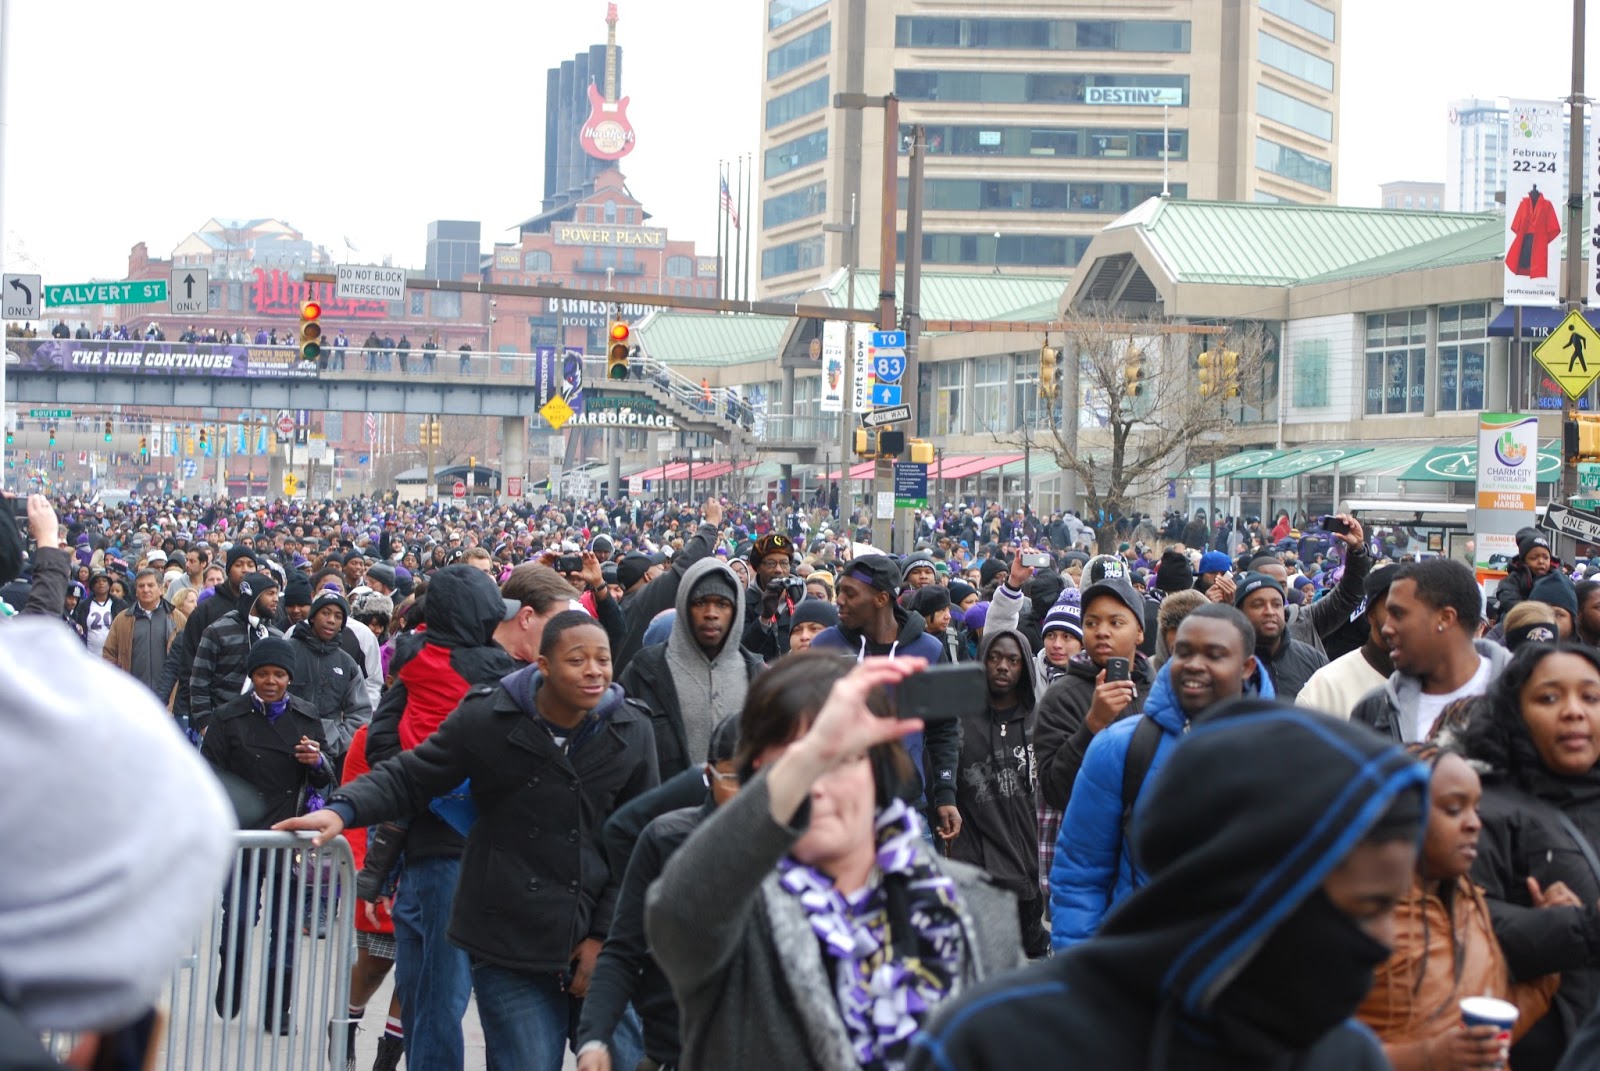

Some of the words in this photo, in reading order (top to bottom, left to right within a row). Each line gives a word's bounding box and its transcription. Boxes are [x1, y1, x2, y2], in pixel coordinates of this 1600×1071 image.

[1090, 88, 1161, 103] DESTINY
[1513, 107, 1559, 117] AMERICAN
[1513, 114, 1539, 122] CRAFT
[1513, 121, 1553, 132] COUNCIL
[1513, 130, 1543, 138] SHOW
[1512, 148, 1558, 159] February
[1512, 160, 1557, 173] 22-24
[561, 228, 610, 243] POWER
[616, 229, 662, 245] PLANT
[340, 268, 352, 279] DO
[355, 270, 372, 281] NOT
[374, 271, 403, 282] BLOCK
[50, 284, 132, 303] CALVERT
[143, 284, 161, 298] ST
[341, 283, 401, 297] INTERSECTION
[1507, 288, 1556, 297] craftcouncil.org
[8, 307, 34, 316] ONLY
[177, 302, 202, 311] ONLY
[562, 317, 605, 327] BOOKS
[1531, 326, 1549, 337] TIR
[881, 334, 897, 345] TO
[71, 350, 102, 365] THE
[107, 352, 142, 366] RIDE
[145, 353, 234, 369] CONTINUES
[856, 340, 864, 372] show
[877, 358, 901, 376] 83
[540, 350, 549, 405] RAVENSTOWN
[1367, 388, 1383, 399] IRISH
[1387, 387, 1401, 398] BAR
[590, 400, 615, 408] VALET
[617, 400, 653, 410] PARKING
[1539, 397, 1563, 408] SECON
[568, 413, 674, 428] HARBORPLACE
[873, 413, 889, 422] ONE
[890, 410, 907, 418] WAY
[1487, 467, 1516, 476] CHARM
[1517, 468, 1532, 477] CITY
[1580, 473, 1600, 487] LIGH
[1498, 493, 1522, 501] INNER
[1493, 500, 1524, 509] HARBOR
[1563, 516, 1584, 530] ONE
[1589, 526, 1600, 538] WA
[90, 611, 112, 630] 20
